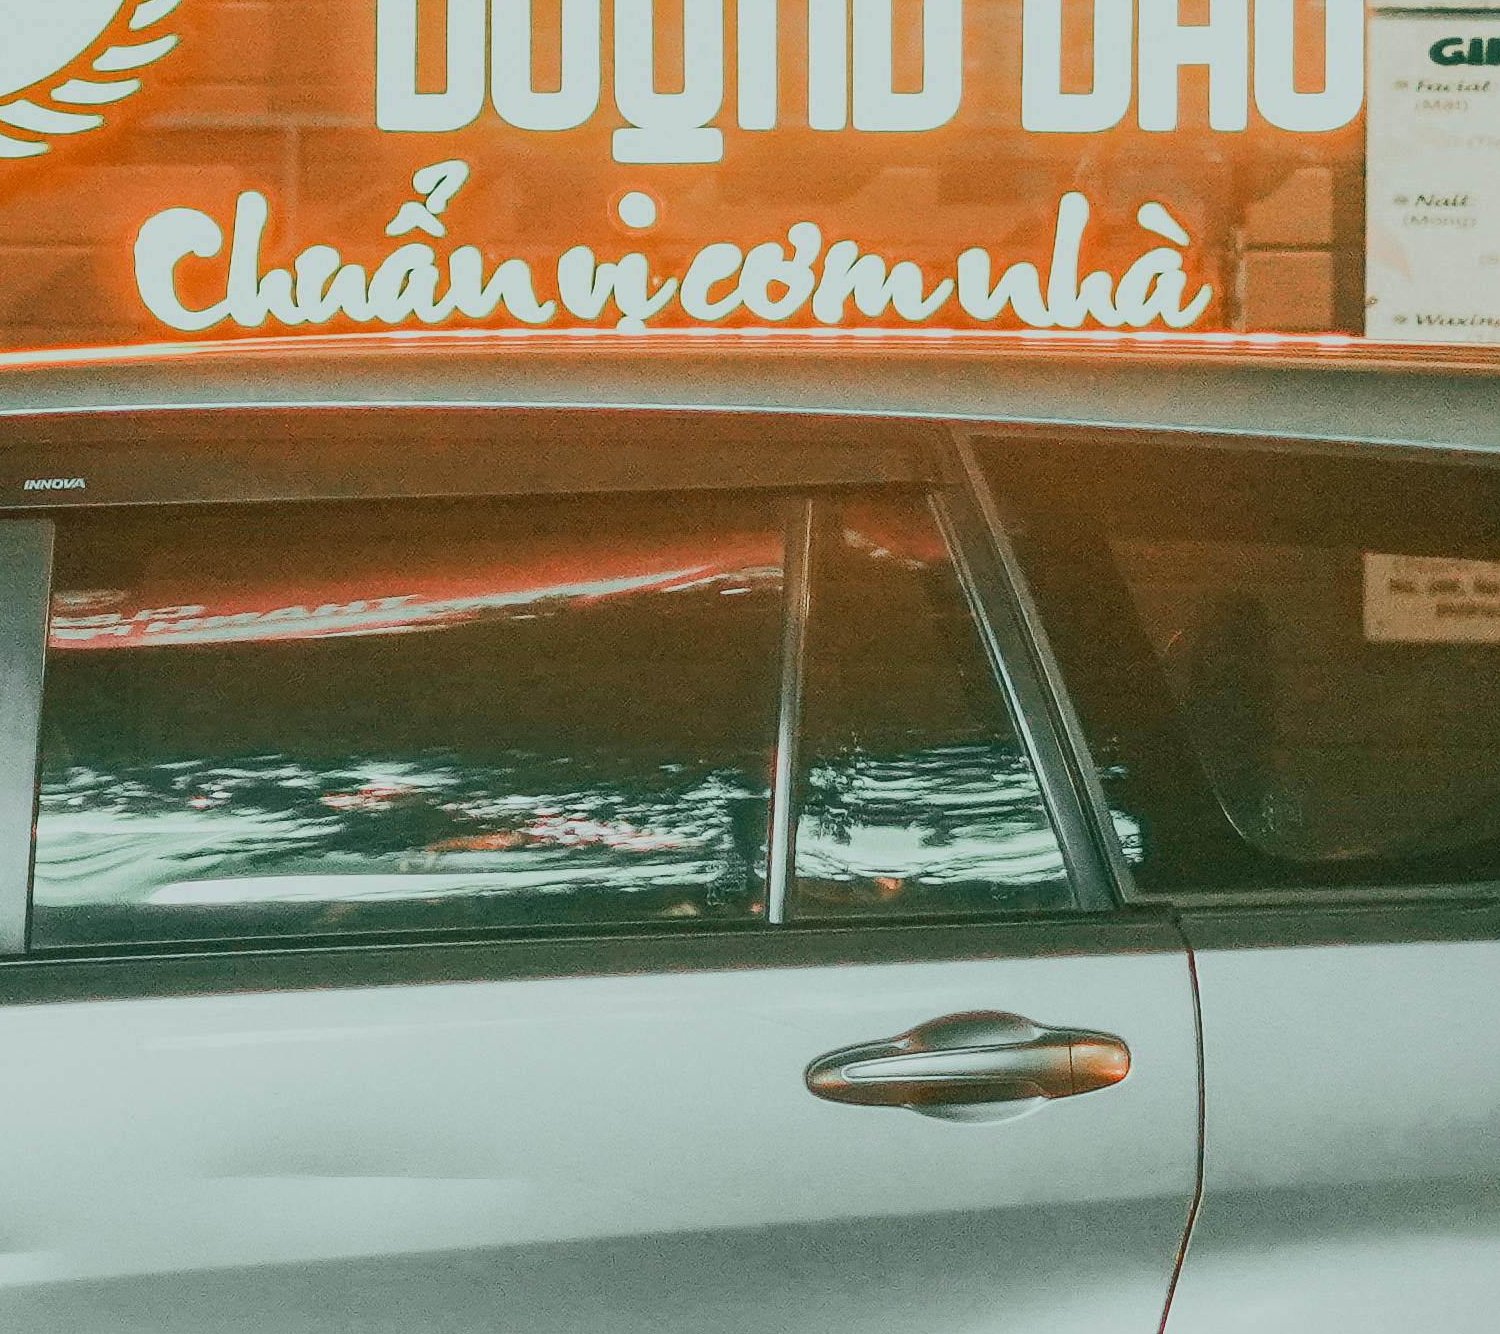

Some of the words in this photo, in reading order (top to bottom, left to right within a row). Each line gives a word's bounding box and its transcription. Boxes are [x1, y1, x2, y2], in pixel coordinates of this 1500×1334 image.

[133, 160, 556, 332] Chuẩn
[557, 190, 681, 336] vị
[680, 220, 956, 326] cơm
[955, 190, 1213, 330] nhà
[23, 477, 86, 491] INNOVA
